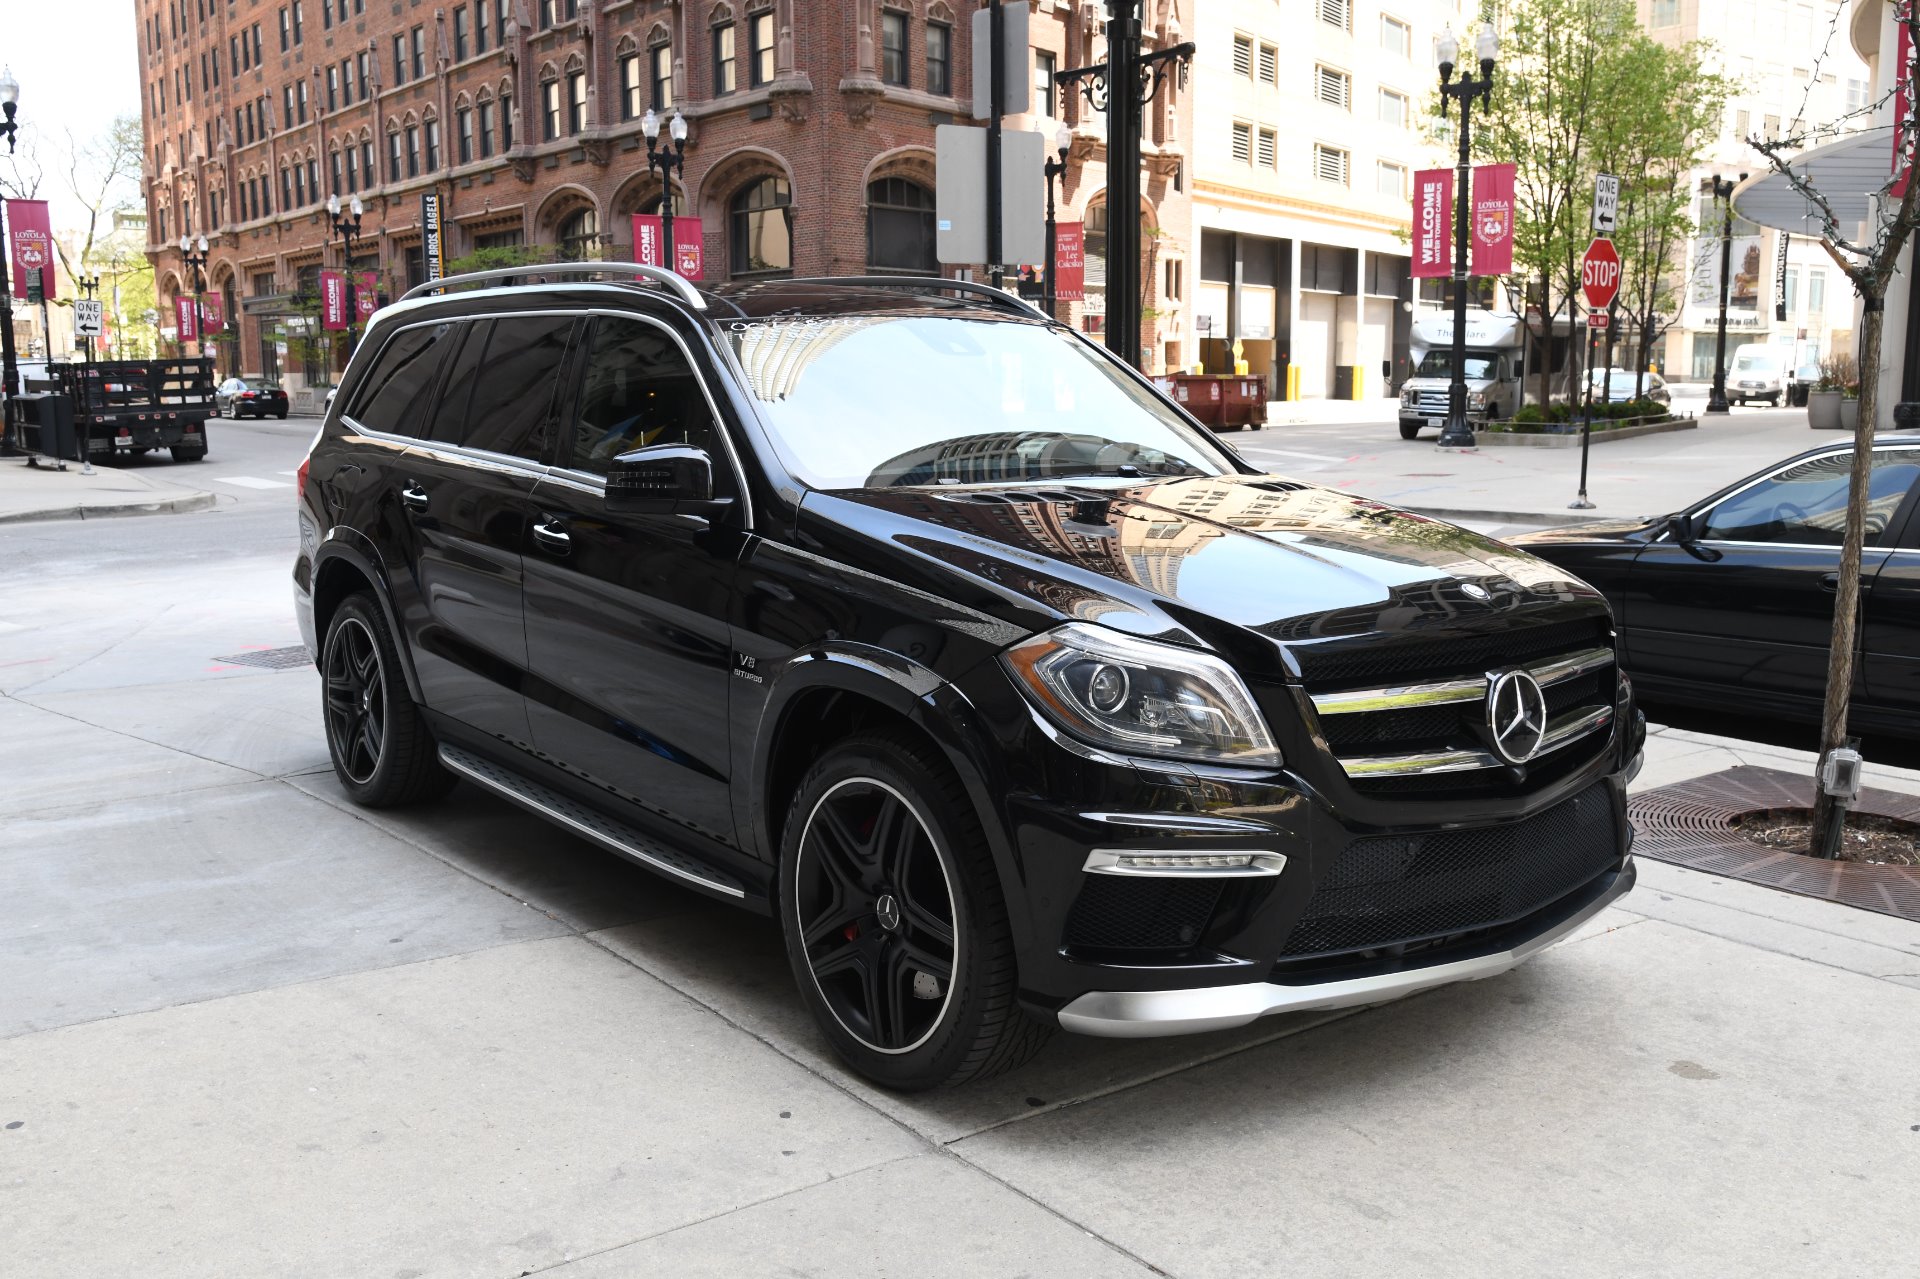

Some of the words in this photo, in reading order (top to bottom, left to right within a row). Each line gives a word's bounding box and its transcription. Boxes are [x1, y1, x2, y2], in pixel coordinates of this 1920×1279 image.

[1599, 179, 1616, 194] ONE
[1435, 182, 1443, 213] CAMPUS
[1478, 200, 1509, 209] LOYOLA
[1598, 196, 1616, 209] WAY
[426, 196, 438, 230] BAGELS
[1422, 182, 1435, 265] WELCOME
[15, 231, 47, 240] LOYOLA
[1058, 242, 1078, 252] David
[1776, 230, 1787, 279] ORDSTROM
[1066, 251, 1079, 259] Lee
[1584, 260, 1618, 287] STOP
[77, 302, 100, 312] ONE
[328, 279, 336, 322] WELCOME
[77, 312, 100, 322] WAY
[1465, 331, 1487, 339] lare
[739, 653, 756, 668] V8
[733, 668, 763, 684] BITURBO
